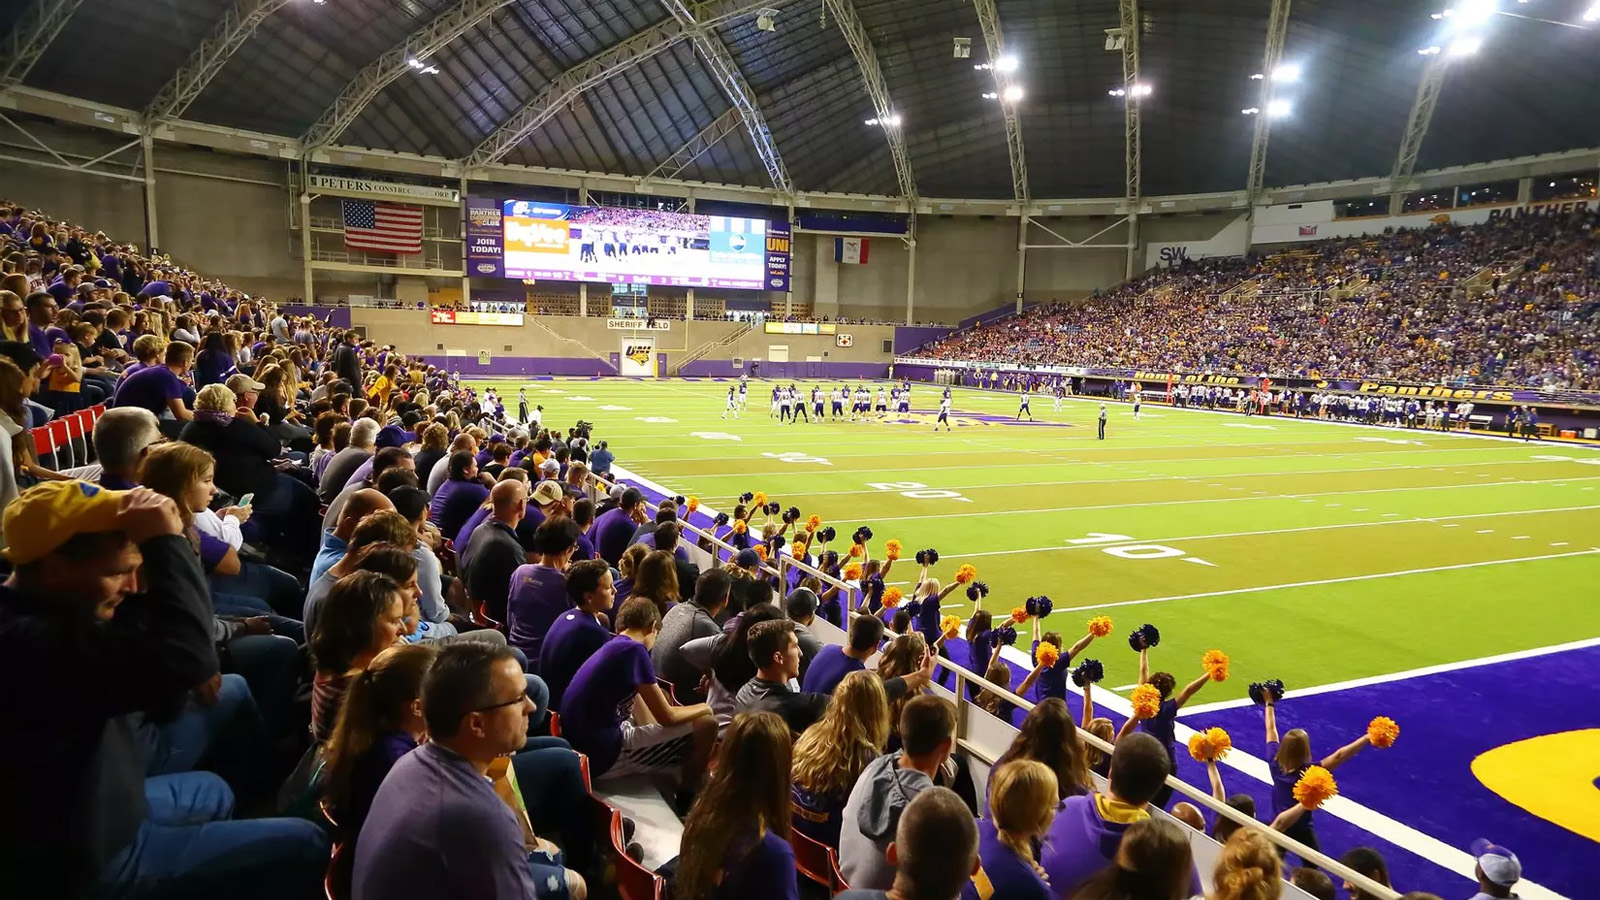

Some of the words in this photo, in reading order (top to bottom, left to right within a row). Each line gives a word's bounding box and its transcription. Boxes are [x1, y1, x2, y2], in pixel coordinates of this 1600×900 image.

[321, 177, 372, 191] PETERS
[373, 184, 430, 197] CONSTRUC
[1489, 200, 1589, 224] PANTHER
[482, 219, 500, 227] CLUB
[766, 238, 789, 252] UNI
[1159, 247, 1187, 261] SW
[609, 320, 643, 328] SHERIFF
[646, 321, 669, 329] ELD
[1134, 370, 1181, 382] Home
[1185, 374, 1206, 383] of
[1207, 375, 1240, 385] the
[1358, 381, 1515, 401] Panthers
